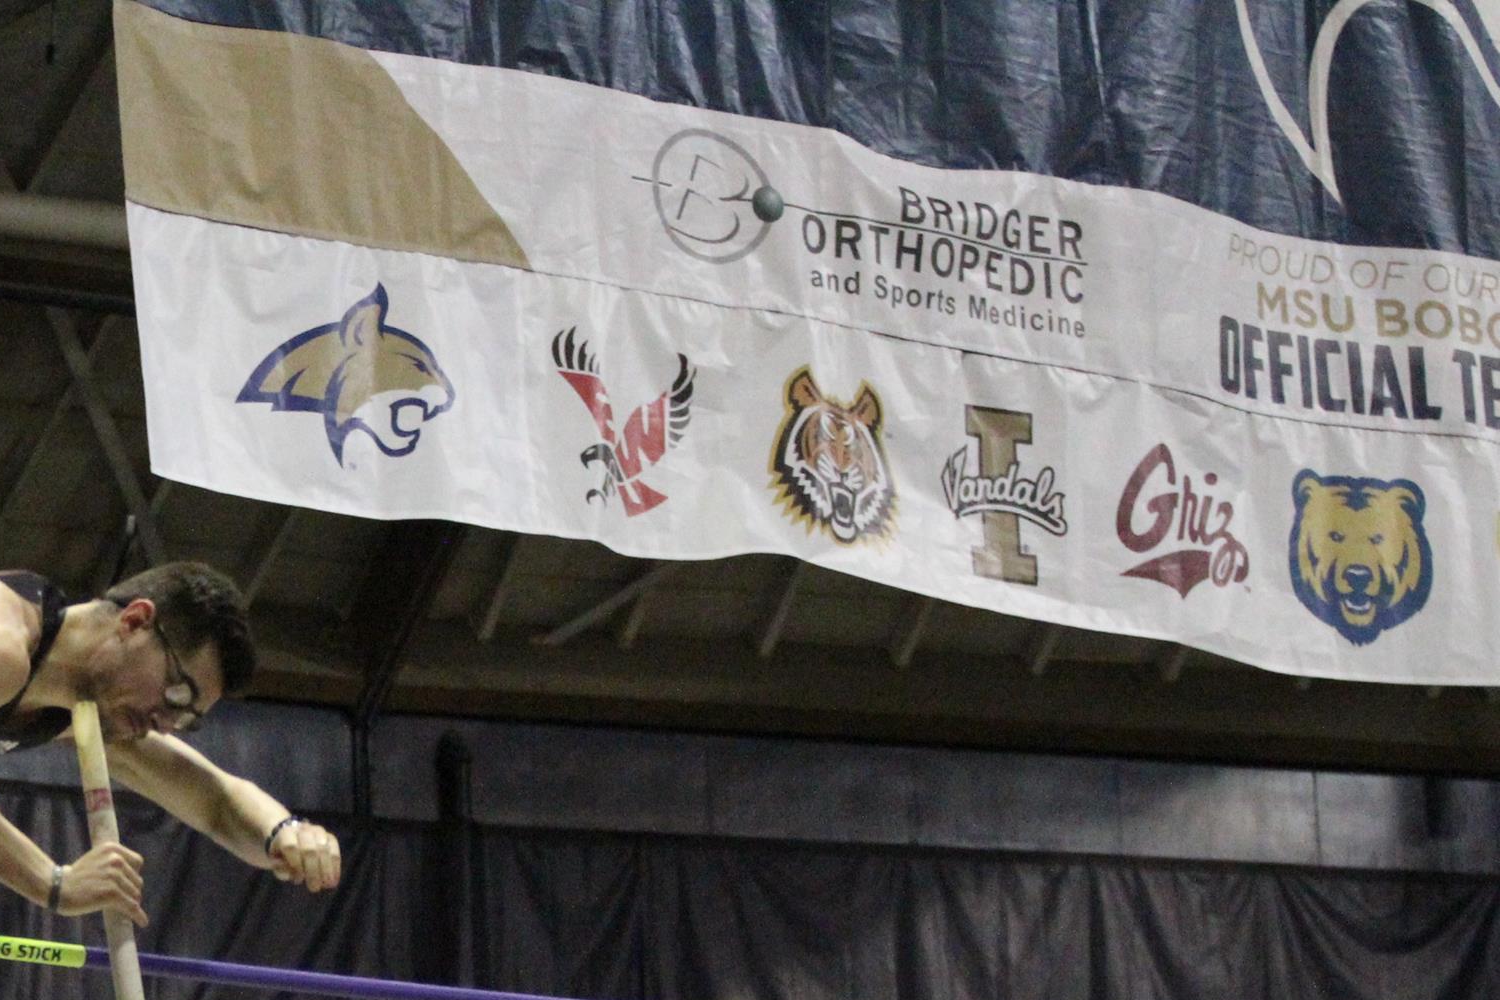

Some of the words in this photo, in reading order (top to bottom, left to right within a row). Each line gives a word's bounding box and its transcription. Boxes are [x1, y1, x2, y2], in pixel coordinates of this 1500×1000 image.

[801, 213, 1085, 304] ORTHOPEDIC
[898, 185, 1083, 260] BRIDGER
[810, 267, 861, 297] and
[873, 276, 957, 317] Sports
[968, 293, 1087, 339] Medicine
[1228, 232, 1336, 285] PROUD
[1349, 259, 1409, 292] OF
[1422, 263, 1500, 304] OUR
[1256, 281, 1357, 334] MSU
[1218, 315, 1443, 421] OFFICIAL
[940, 444, 1067, 534] Vandals
[17, 944, 63, 962] STICK
